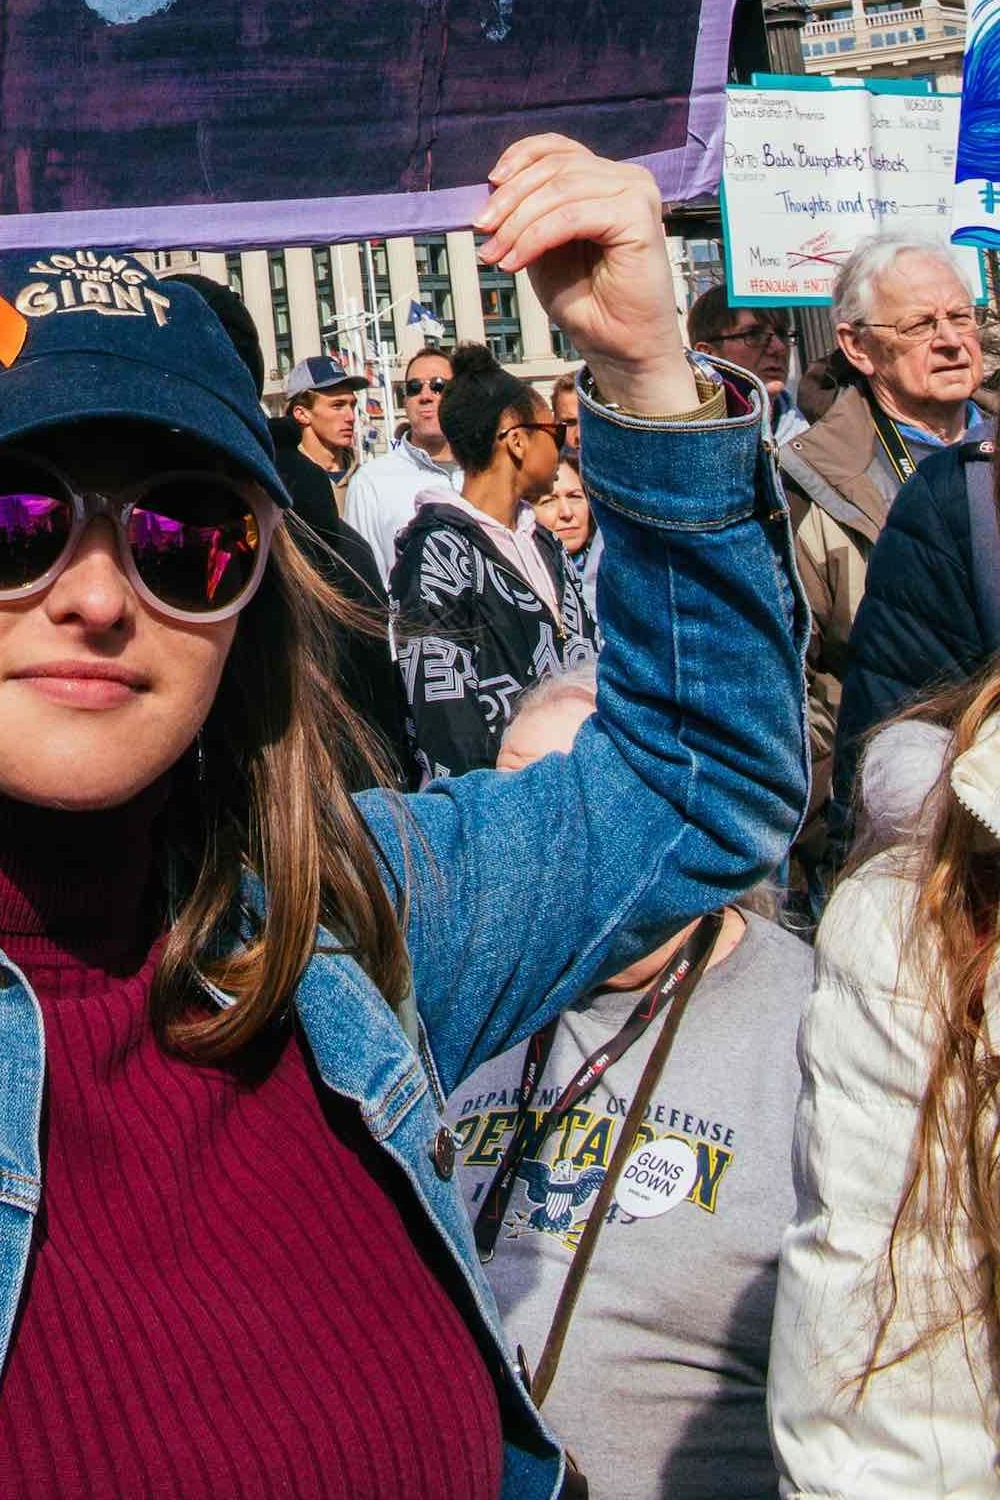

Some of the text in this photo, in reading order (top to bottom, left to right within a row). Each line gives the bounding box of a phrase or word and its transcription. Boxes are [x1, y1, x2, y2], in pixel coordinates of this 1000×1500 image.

[776, 189, 832, 219] Thoughts
[837, 192, 865, 213] and
[29, 250, 148, 285] YOUNG
[749, 278, 798, 294] #ENOUGH
[14, 279, 171, 327] GIANT
[577, 1053, 611, 1087] verizon
[623, 1164, 677, 1197] DOWN
[637, 1151, 685, 1181] GUNS
